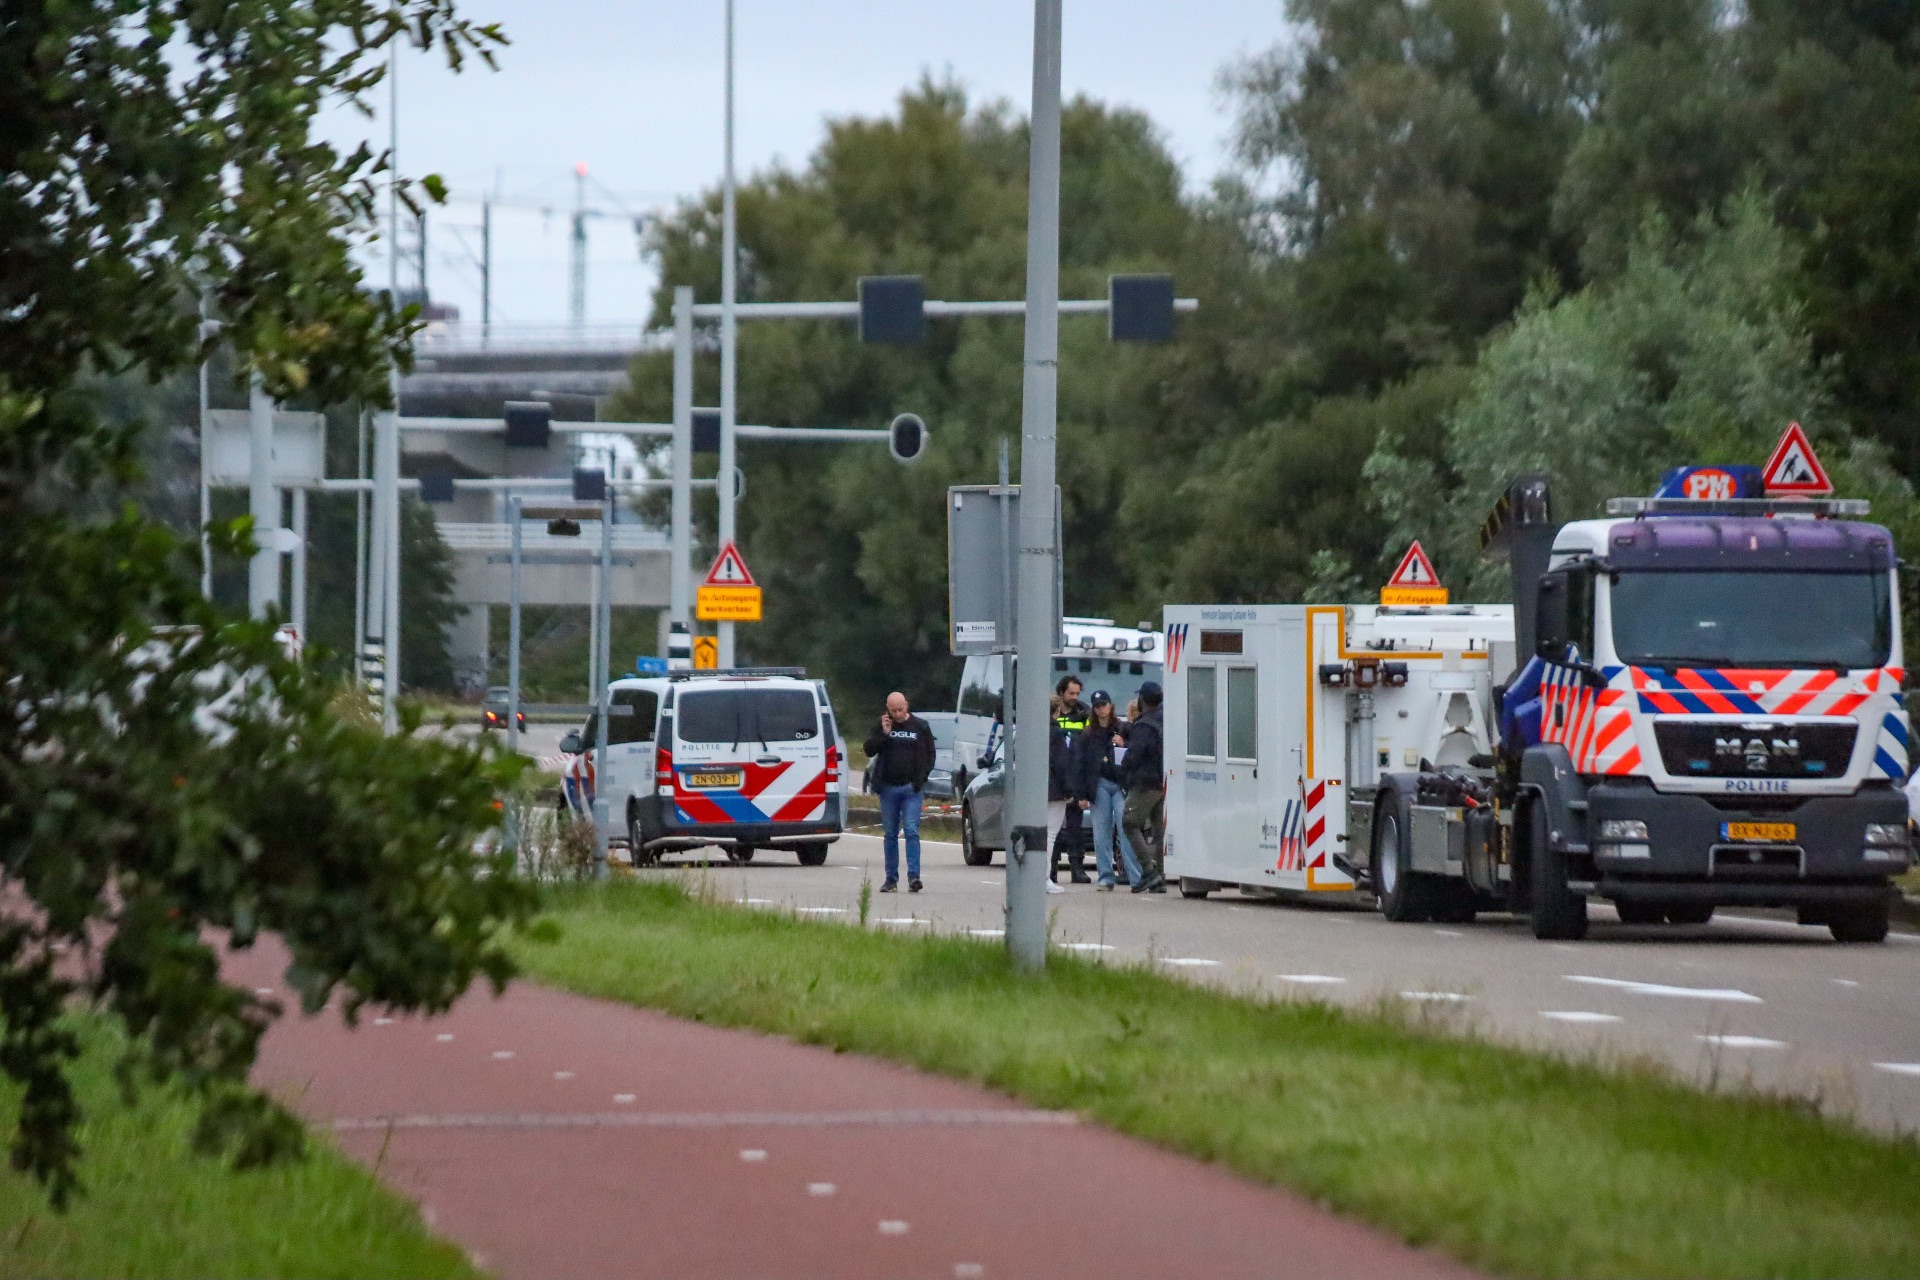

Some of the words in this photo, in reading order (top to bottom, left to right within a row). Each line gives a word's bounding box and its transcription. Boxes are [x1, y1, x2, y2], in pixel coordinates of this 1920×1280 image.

[1689, 474, 1730, 500] PM
[1715, 738, 1799, 755] MAN
[1725, 780, 1789, 792] POLITIE
